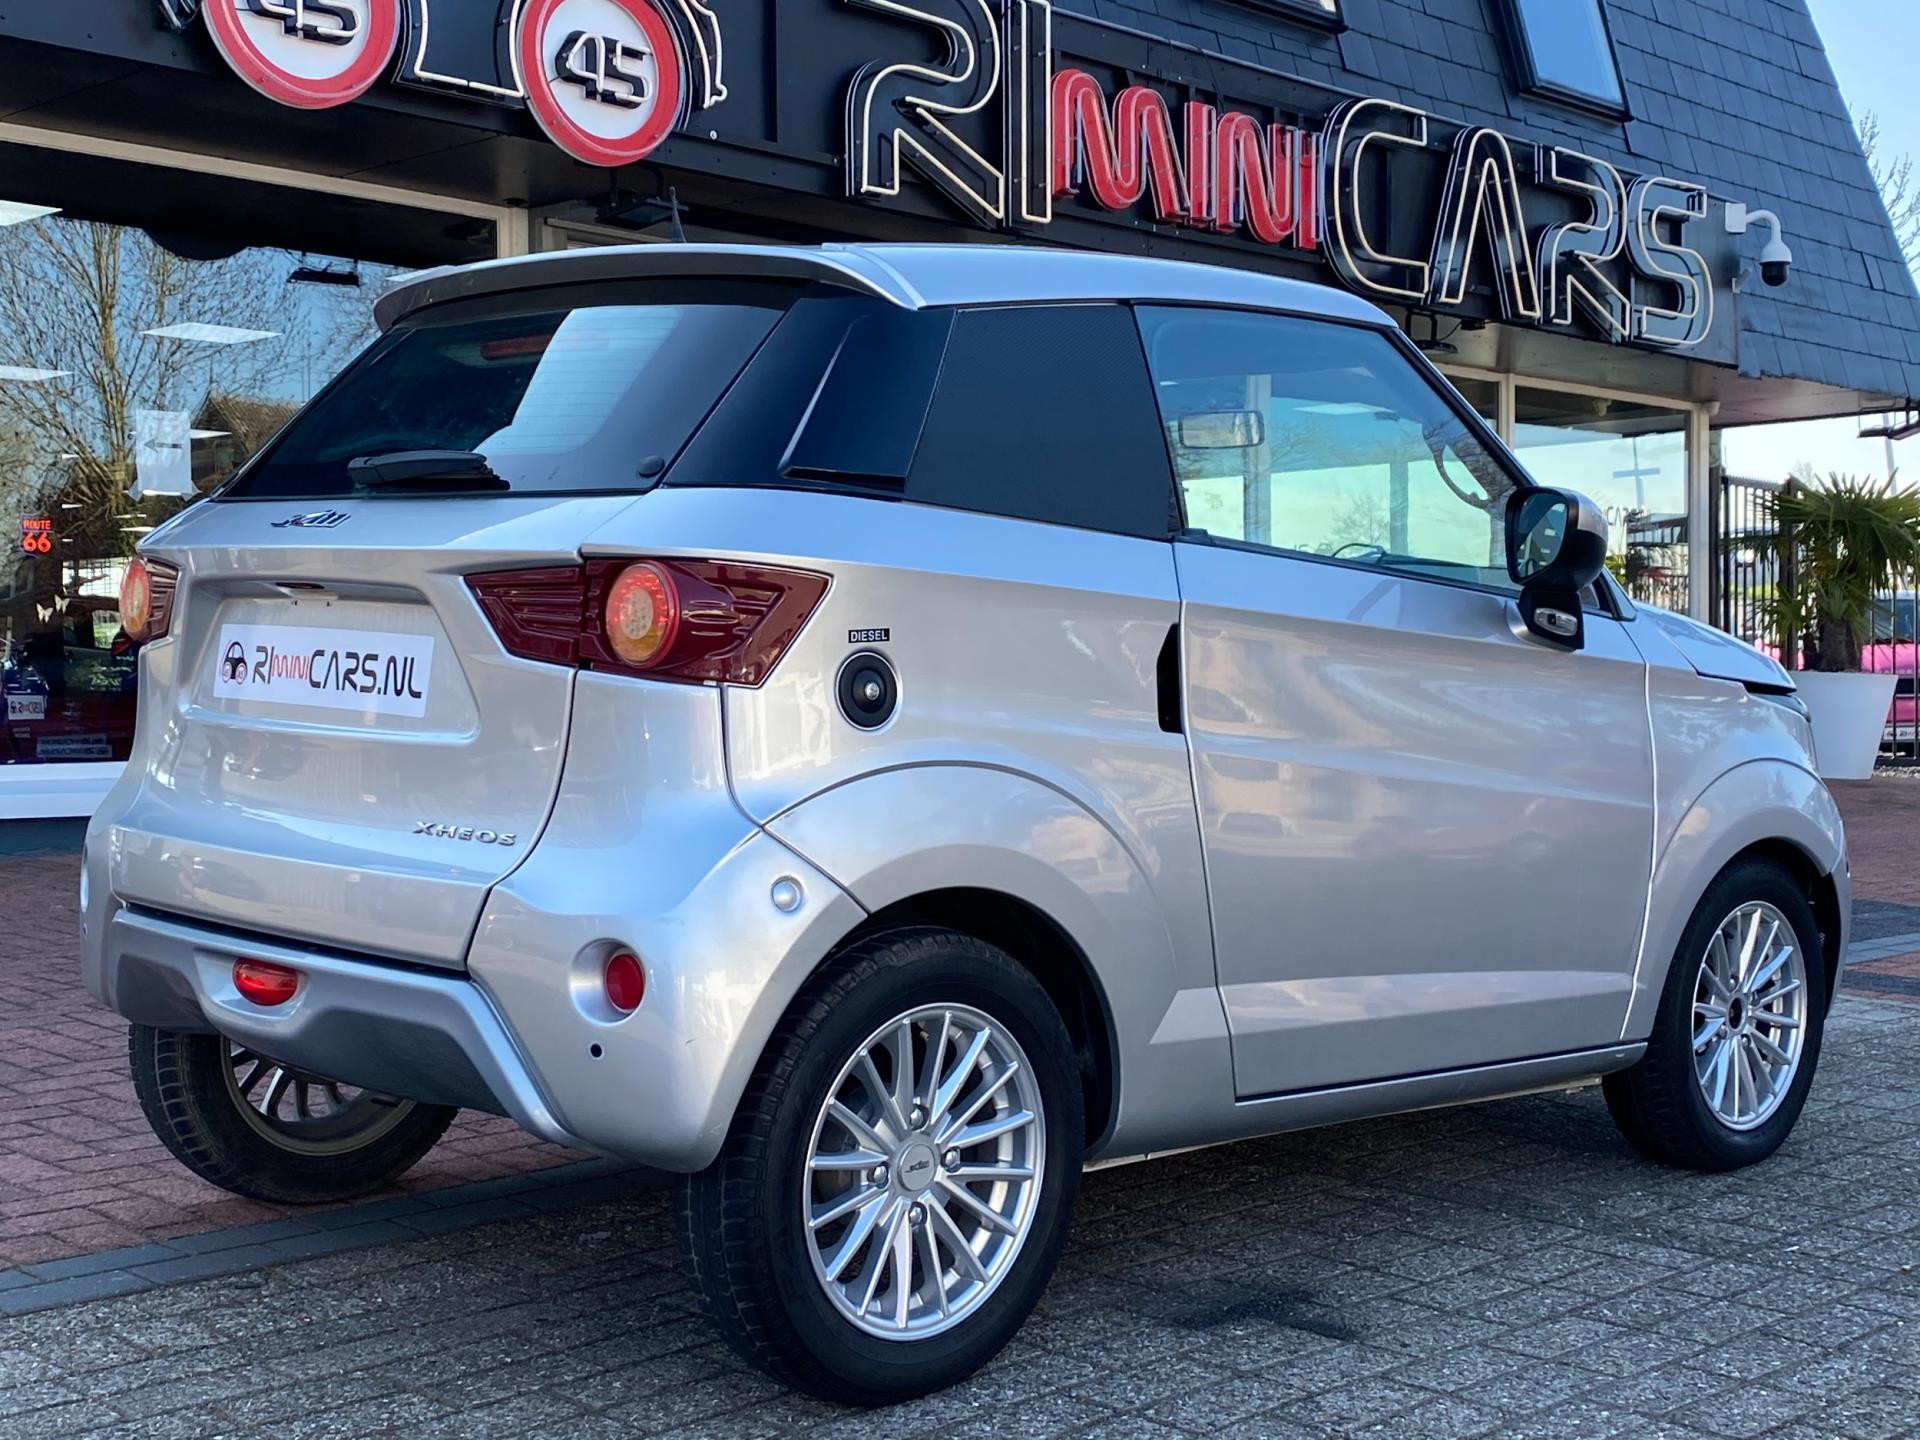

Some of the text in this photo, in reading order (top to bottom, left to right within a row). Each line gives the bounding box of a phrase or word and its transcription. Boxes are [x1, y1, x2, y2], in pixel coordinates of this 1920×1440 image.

[555, 30, 653, 109] 45
[23, 519, 51, 529] ROUTE
[23, 531, 51, 552] 66
[850, 630, 888, 642] DIESEL
